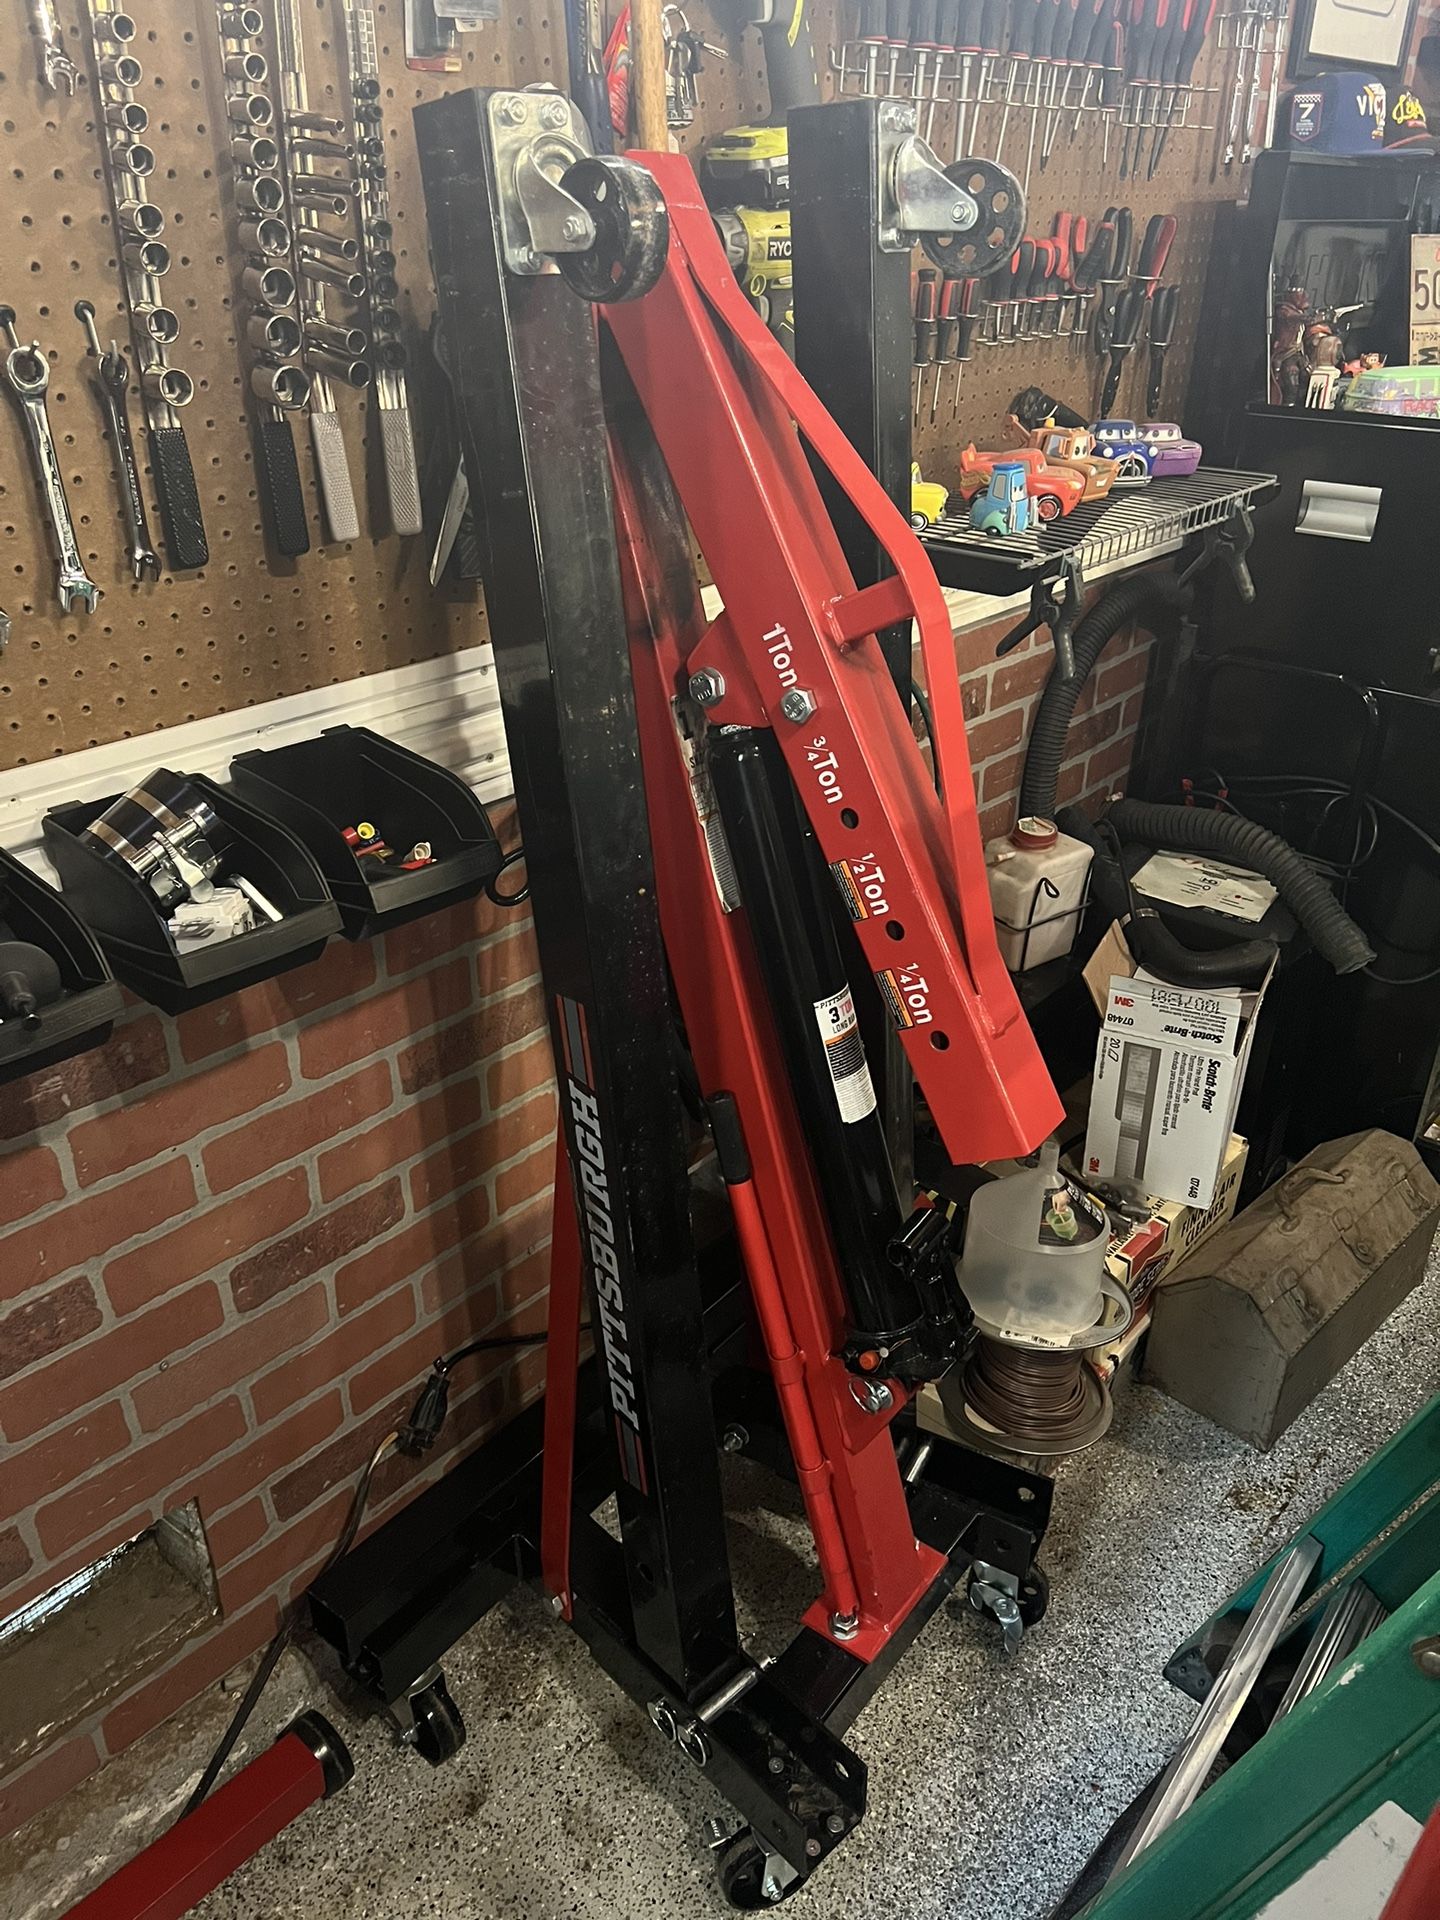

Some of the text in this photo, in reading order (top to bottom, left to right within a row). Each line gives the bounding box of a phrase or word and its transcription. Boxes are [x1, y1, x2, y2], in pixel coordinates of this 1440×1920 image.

[1299, 103, 1316, 119] 7
[829, 997, 853, 1024] 3 TO
[1114, 995, 1135, 1008] 3M
[1107, 1013, 1134, 1026] 07448
[1110, 1037, 1121, 1049] 20
[1089, 1157, 1100, 1172] 3M
[1188, 1177, 1200, 1199] 07448
[1218, 1172, 1237, 1199] AIR
[1185, 1197, 1226, 1247] CLEANER
[568, 1078, 640, 1432] PITTSBURGH
